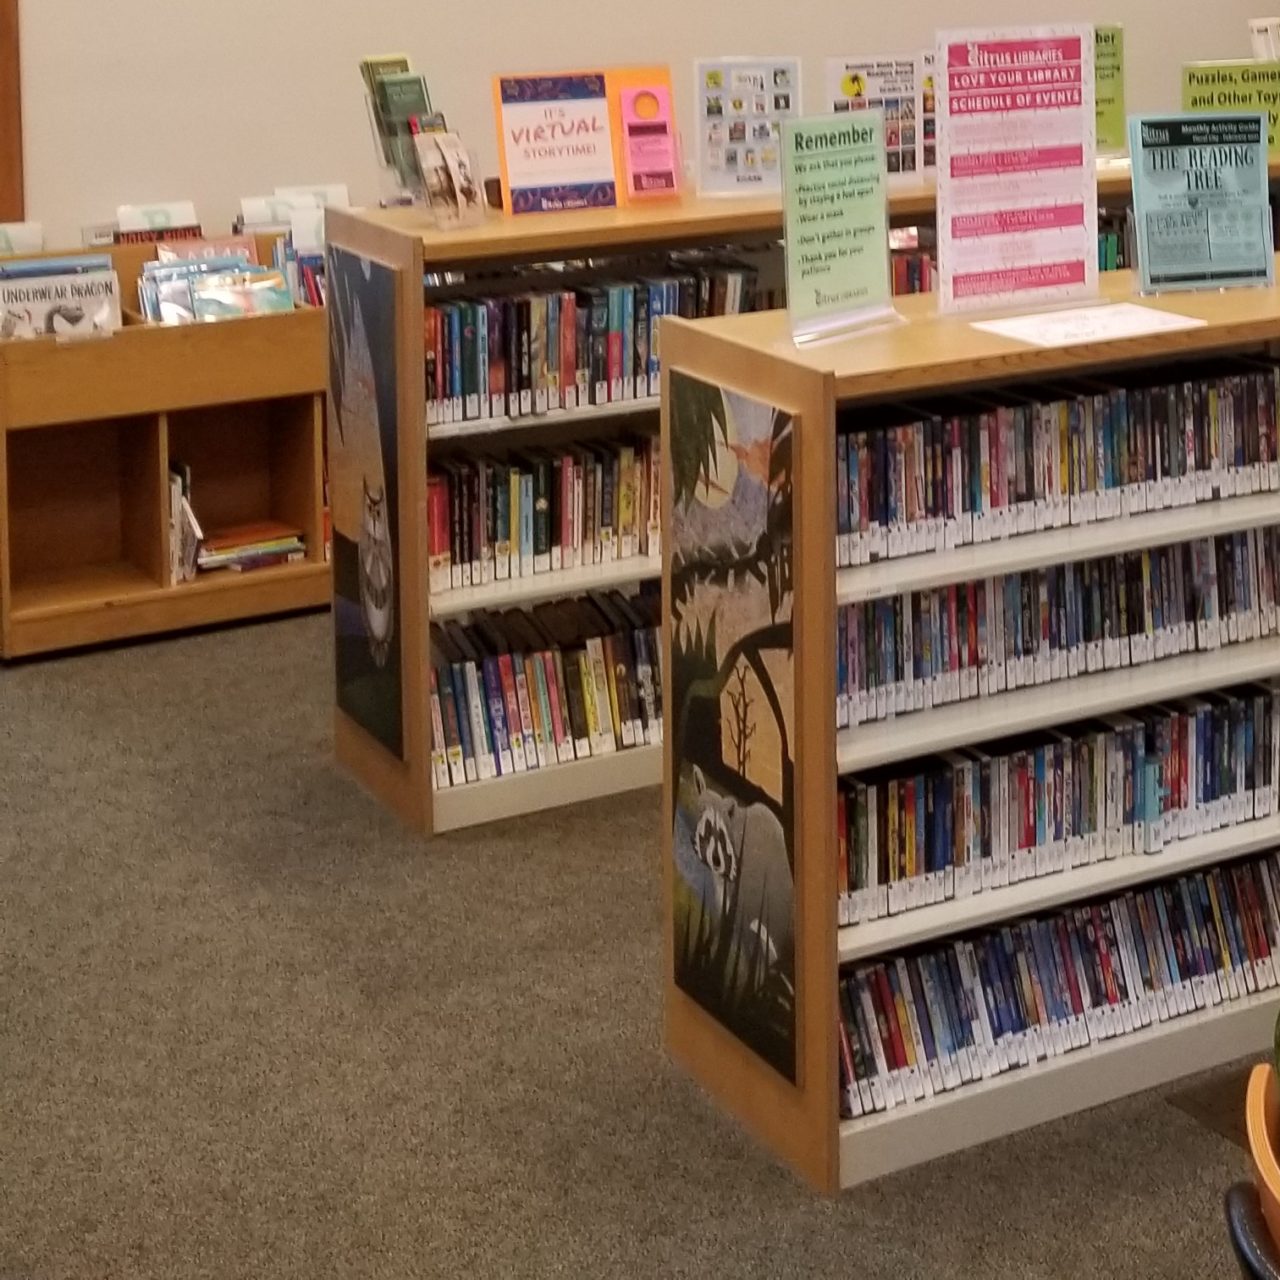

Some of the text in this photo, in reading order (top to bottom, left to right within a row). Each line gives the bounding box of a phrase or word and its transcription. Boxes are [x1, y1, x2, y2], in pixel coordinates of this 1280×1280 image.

[1013, 48, 1064, 66] LIBRARIES
[953, 72, 986, 89] LOVE
[989, 70, 1023, 86] YOUR
[1027, 66, 1077, 83] LIBRARY
[1188, 70, 1238, 86] Puzzles,
[951, 94, 1012, 112] SCHEDULE
[1016, 93, 1032, 107] OF
[1036, 88, 1080, 104] EVENTS
[1191, 91, 1214, 107] and
[1217, 90, 1252, 106] Other
[543, 107, 566, 121] IT'S
[511, 115, 605, 145] VIRTUAL
[794, 123, 875, 152] Remember
[523, 144, 597, 160] STORYTIME!
[1148, 145, 1254, 171] THE READING
[1183, 169, 1223, 191] TREE
[2, 280, 114, 304] UNDERWEAR DRAGON
